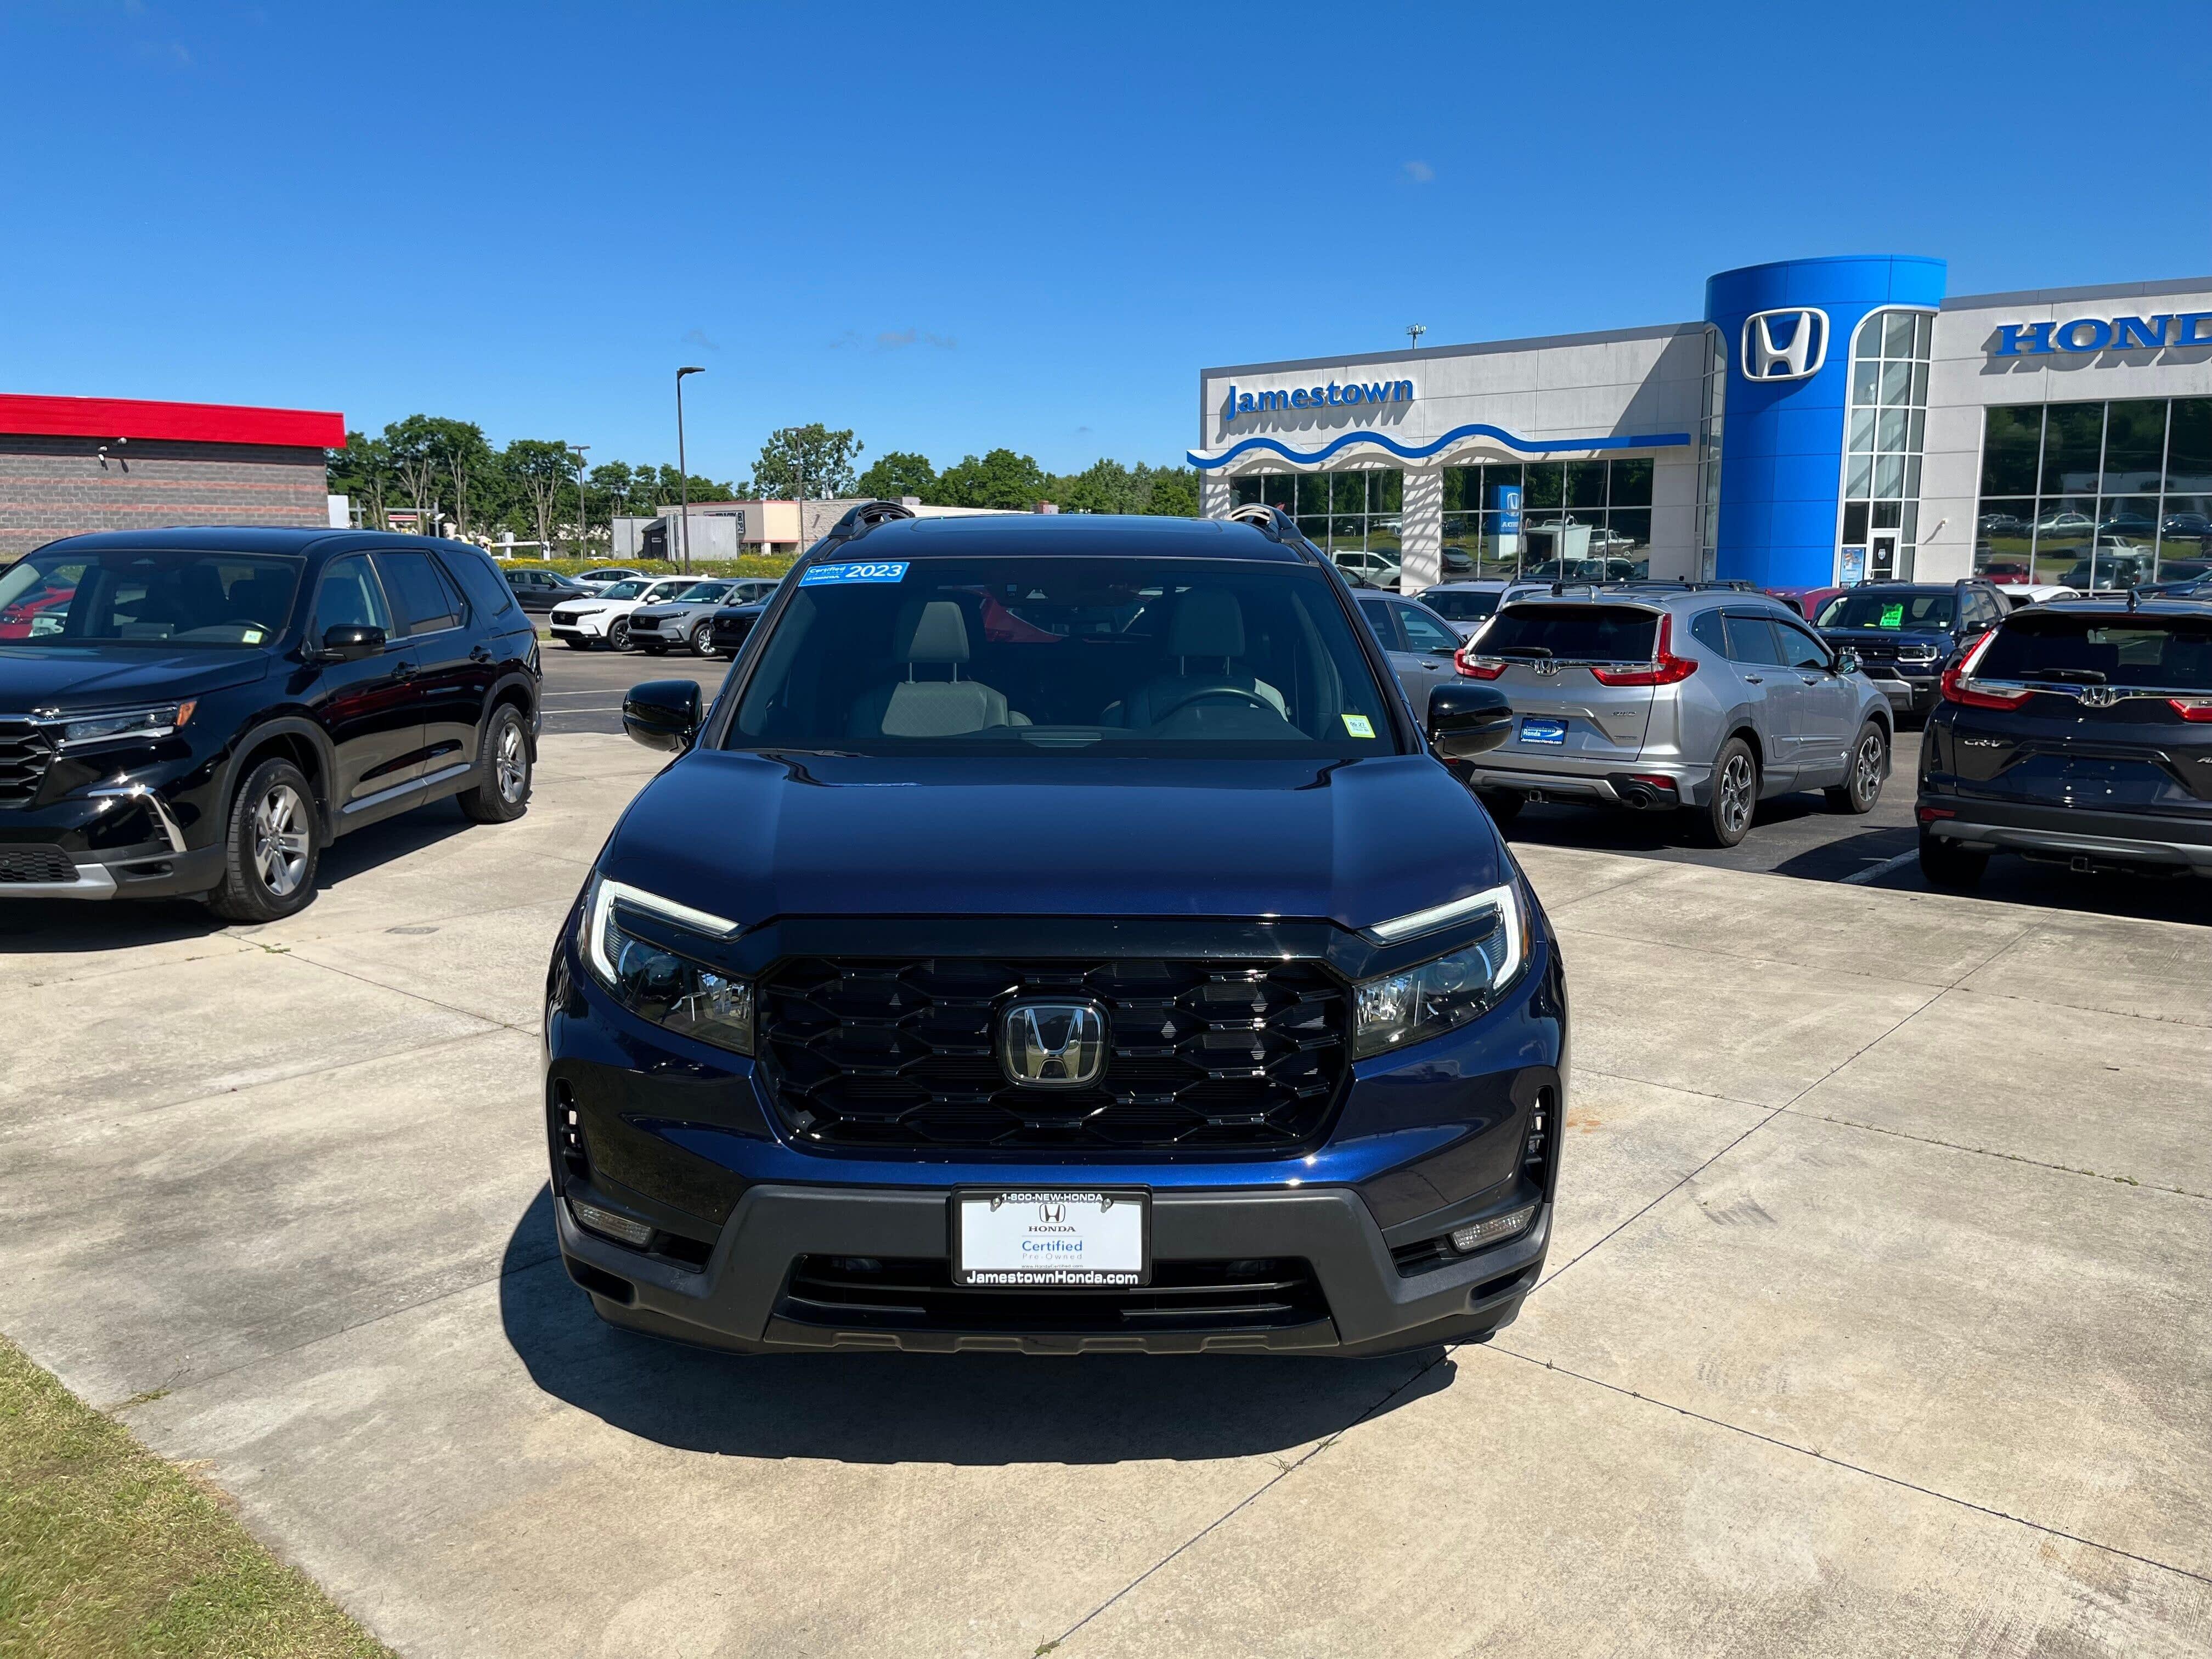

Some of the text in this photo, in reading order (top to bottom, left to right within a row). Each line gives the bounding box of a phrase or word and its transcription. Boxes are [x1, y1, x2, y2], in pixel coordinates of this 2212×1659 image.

[1225, 380, 1414, 421] Jamestown
[845, 564, 903, 578] 2023
[1001, 1193, 1104, 1203] 1-800-NEW-HONDA
[1022, 1240, 1083, 1252] Certified
[966, 1270, 1139, 1285] JamestownHonda.com
